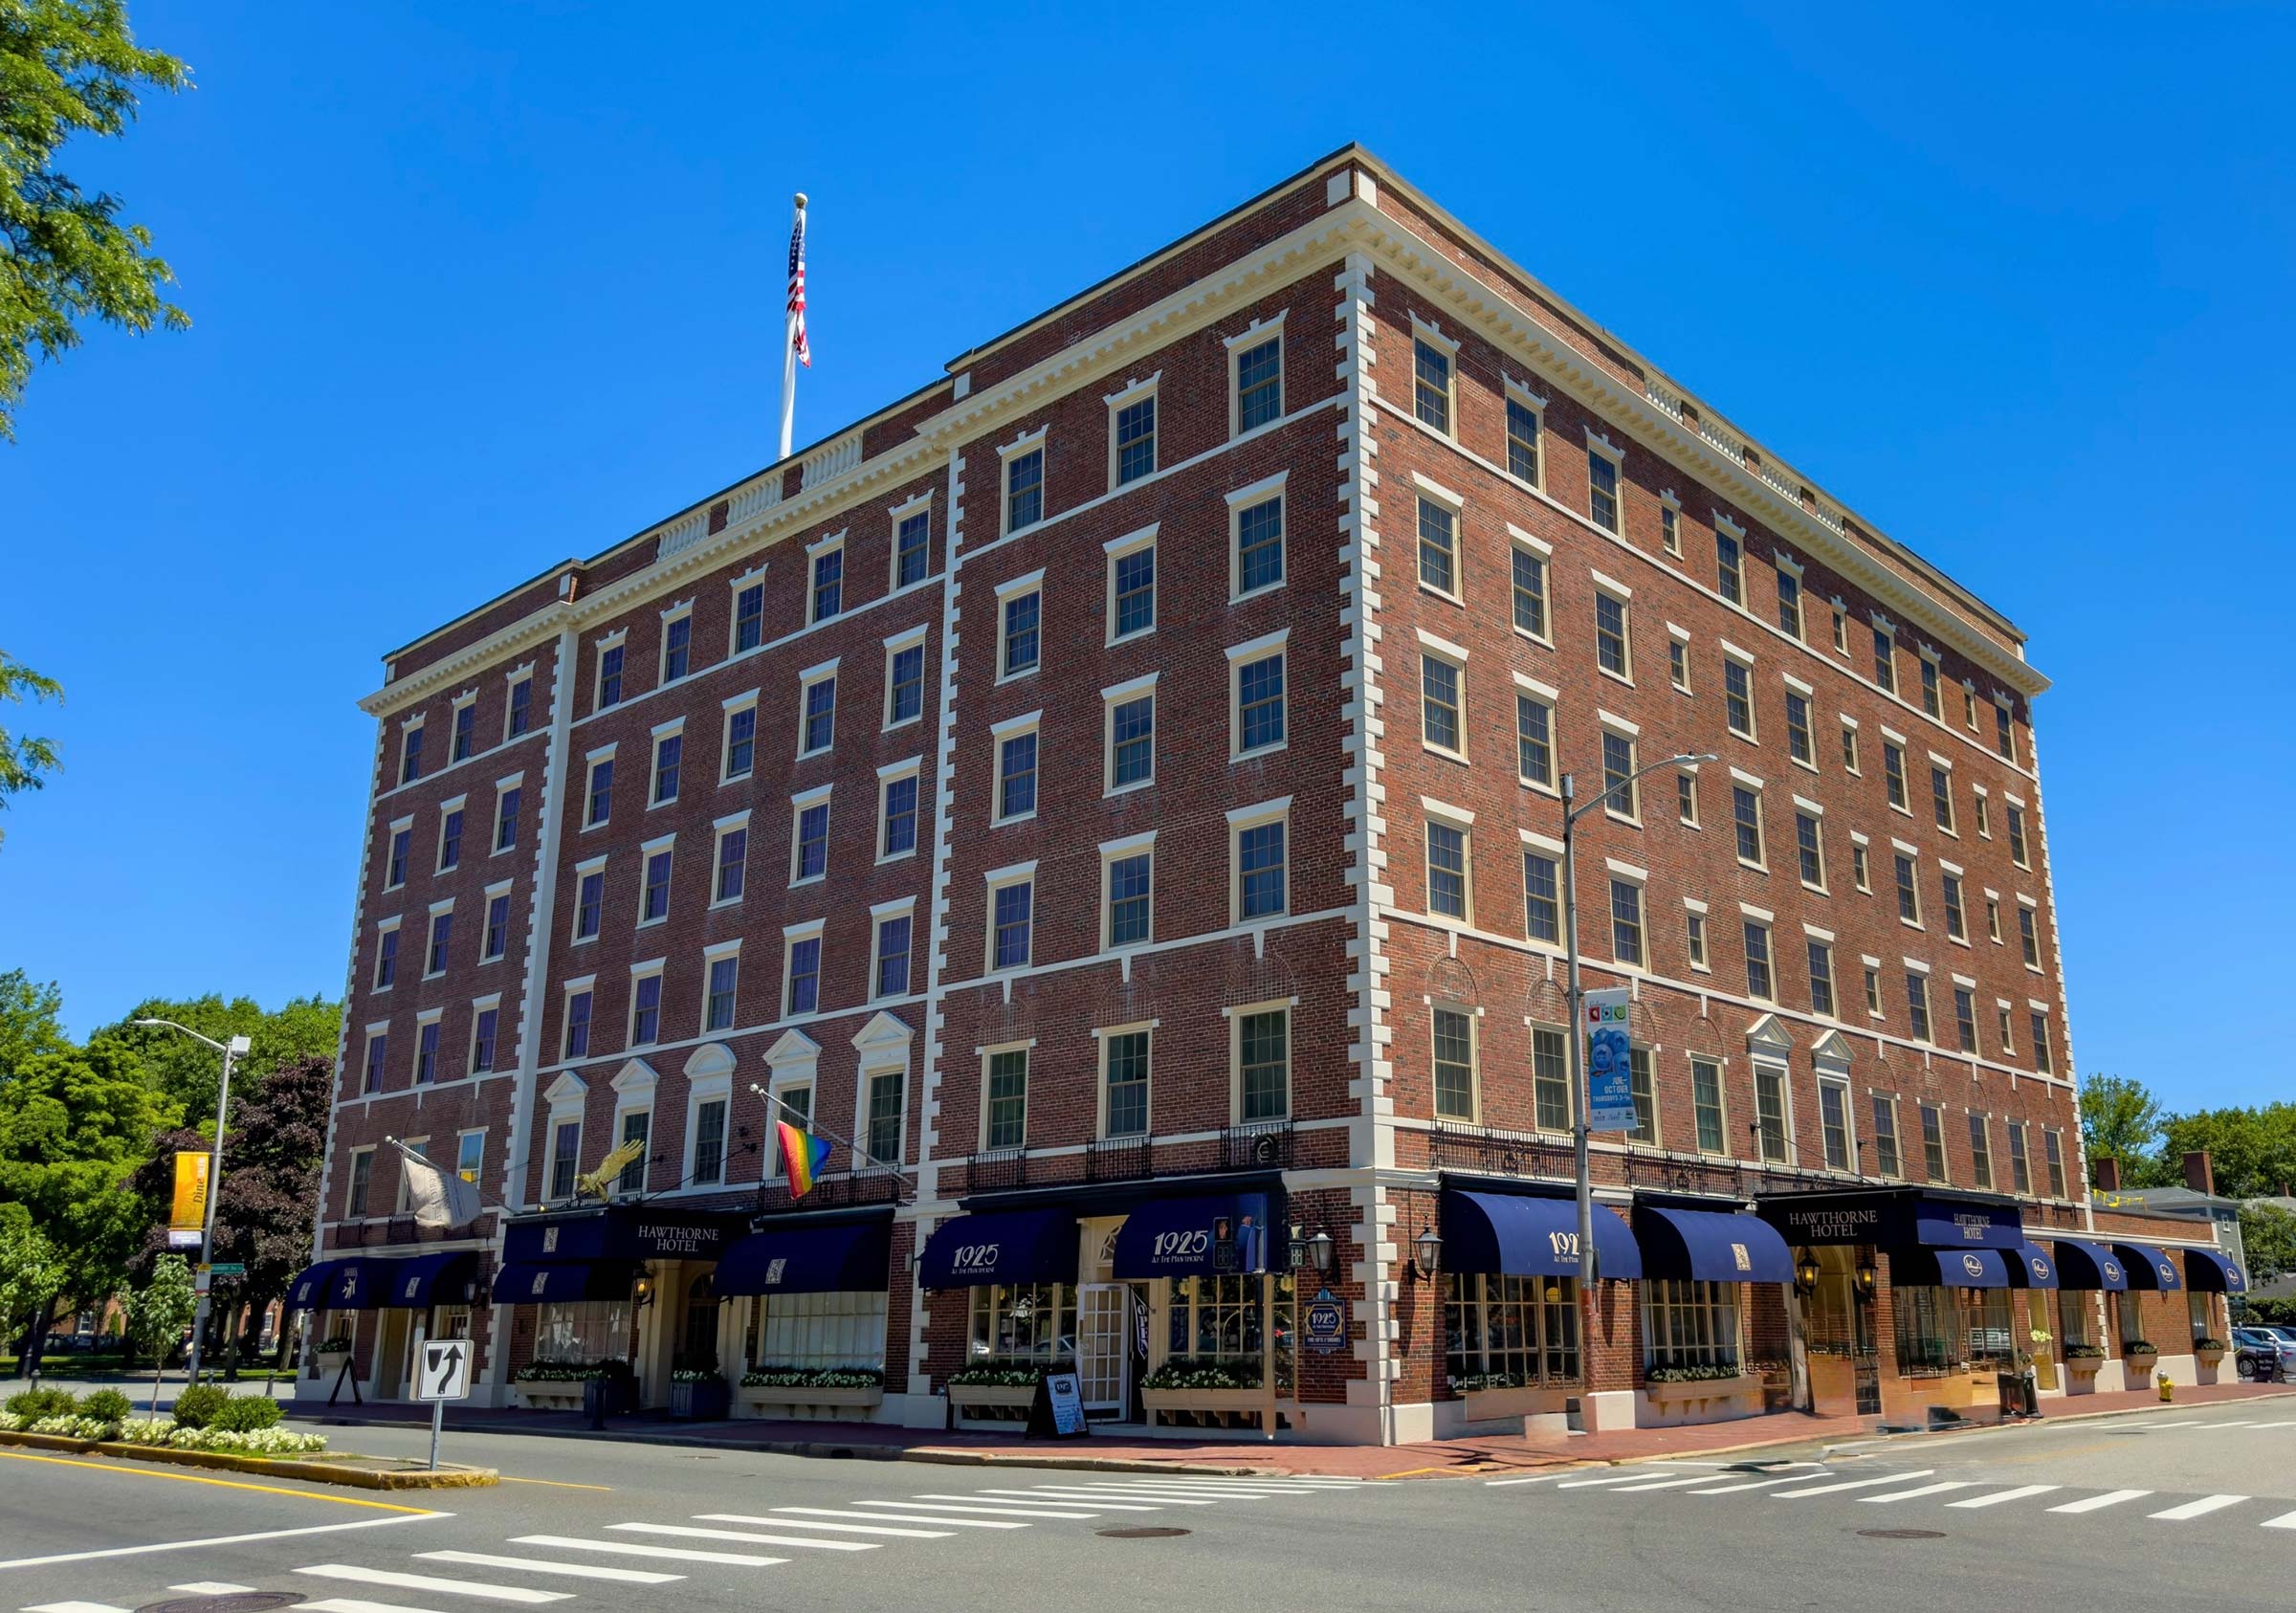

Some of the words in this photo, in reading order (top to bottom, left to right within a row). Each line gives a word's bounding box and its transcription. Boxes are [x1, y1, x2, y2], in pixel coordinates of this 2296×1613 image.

[193, 1178, 204, 1203] Dine
[1789, 1210, 1878, 1225] HAWTHORNE
[1954, 1213, 1991, 1228] HAWTHORNE
[638, 1226, 719, 1240] HAWTHORNE
[1811, 1225, 1858, 1237] HOTEL
[1963, 1226, 1983, 1240] HOTEL
[656, 1239, 698, 1252] HOTEL
[1155, 1230, 1208, 1255] 1925
[1549, 1231, 1579, 1255] 192
[954, 1244, 1000, 1268] 1925
[1312, 1313, 1336, 1325] 1925
